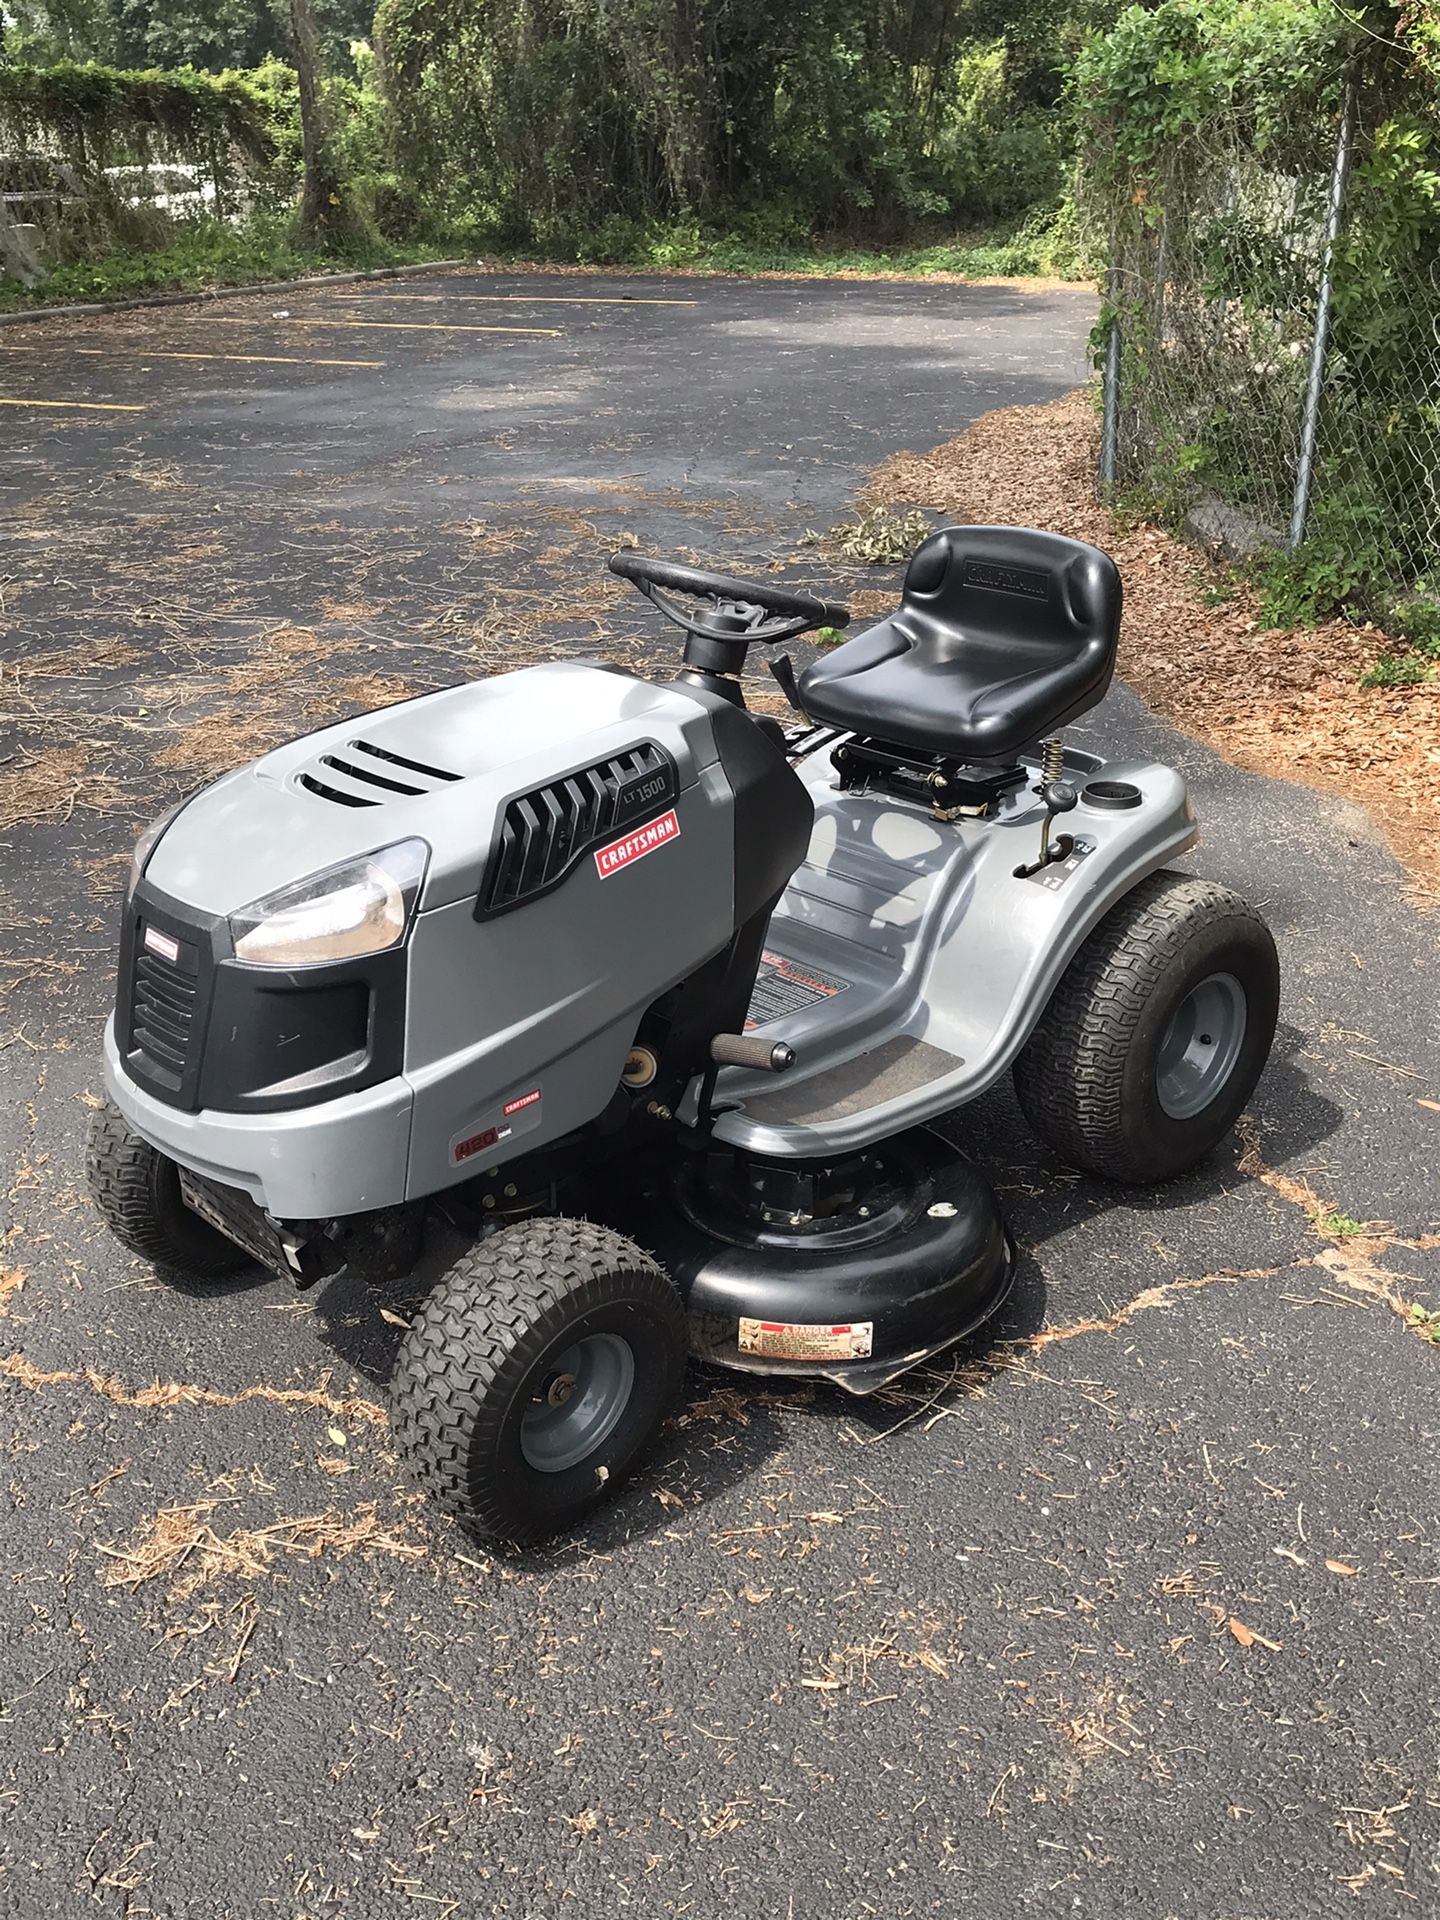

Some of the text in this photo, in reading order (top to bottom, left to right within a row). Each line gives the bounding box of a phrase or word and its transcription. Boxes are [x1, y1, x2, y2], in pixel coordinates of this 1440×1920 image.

[623, 776, 666, 804] LT 1500
[601, 818, 674, 870] CRAFTSMAN
[791, 1325, 833, 1335] DANGER
